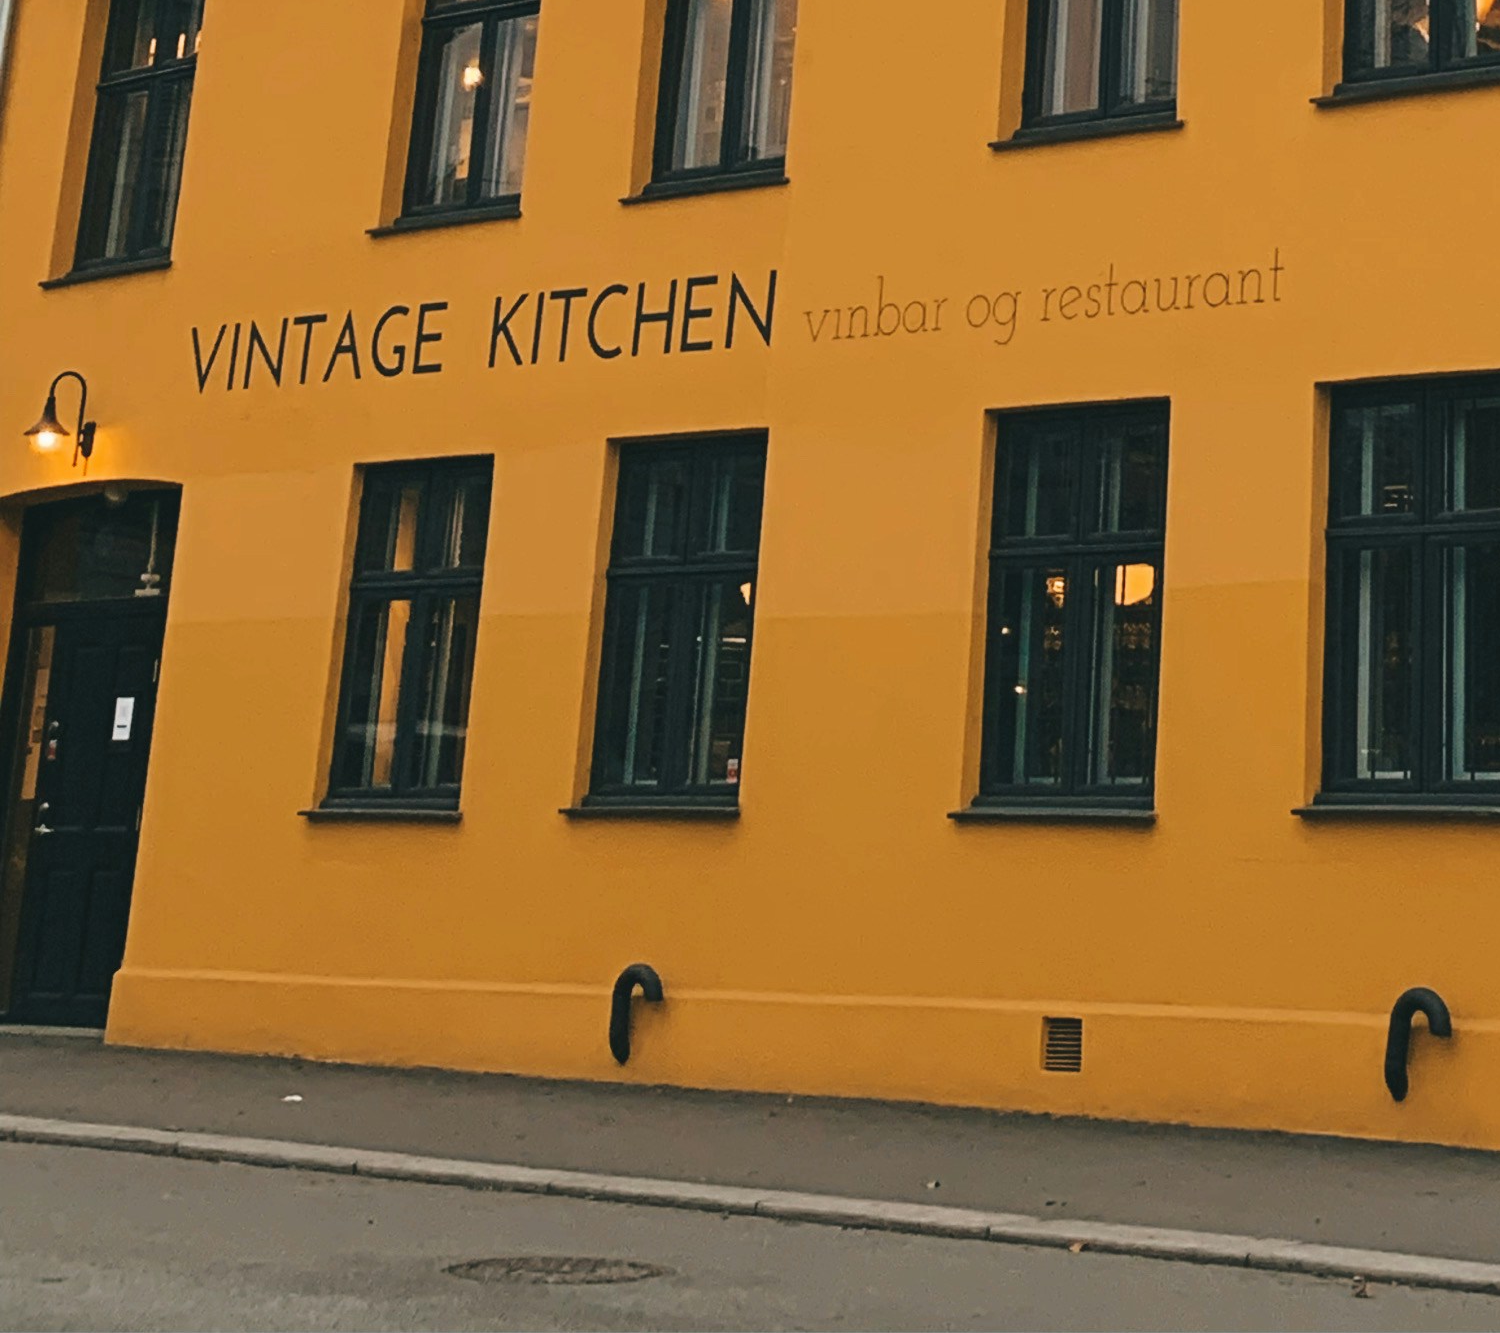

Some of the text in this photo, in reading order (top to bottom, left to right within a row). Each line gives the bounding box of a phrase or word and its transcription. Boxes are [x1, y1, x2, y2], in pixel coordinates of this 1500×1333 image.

[191, 269, 777, 394] VINTAGE KITCHEN
[804, 247, 1285, 346] vinbar og restaurant
